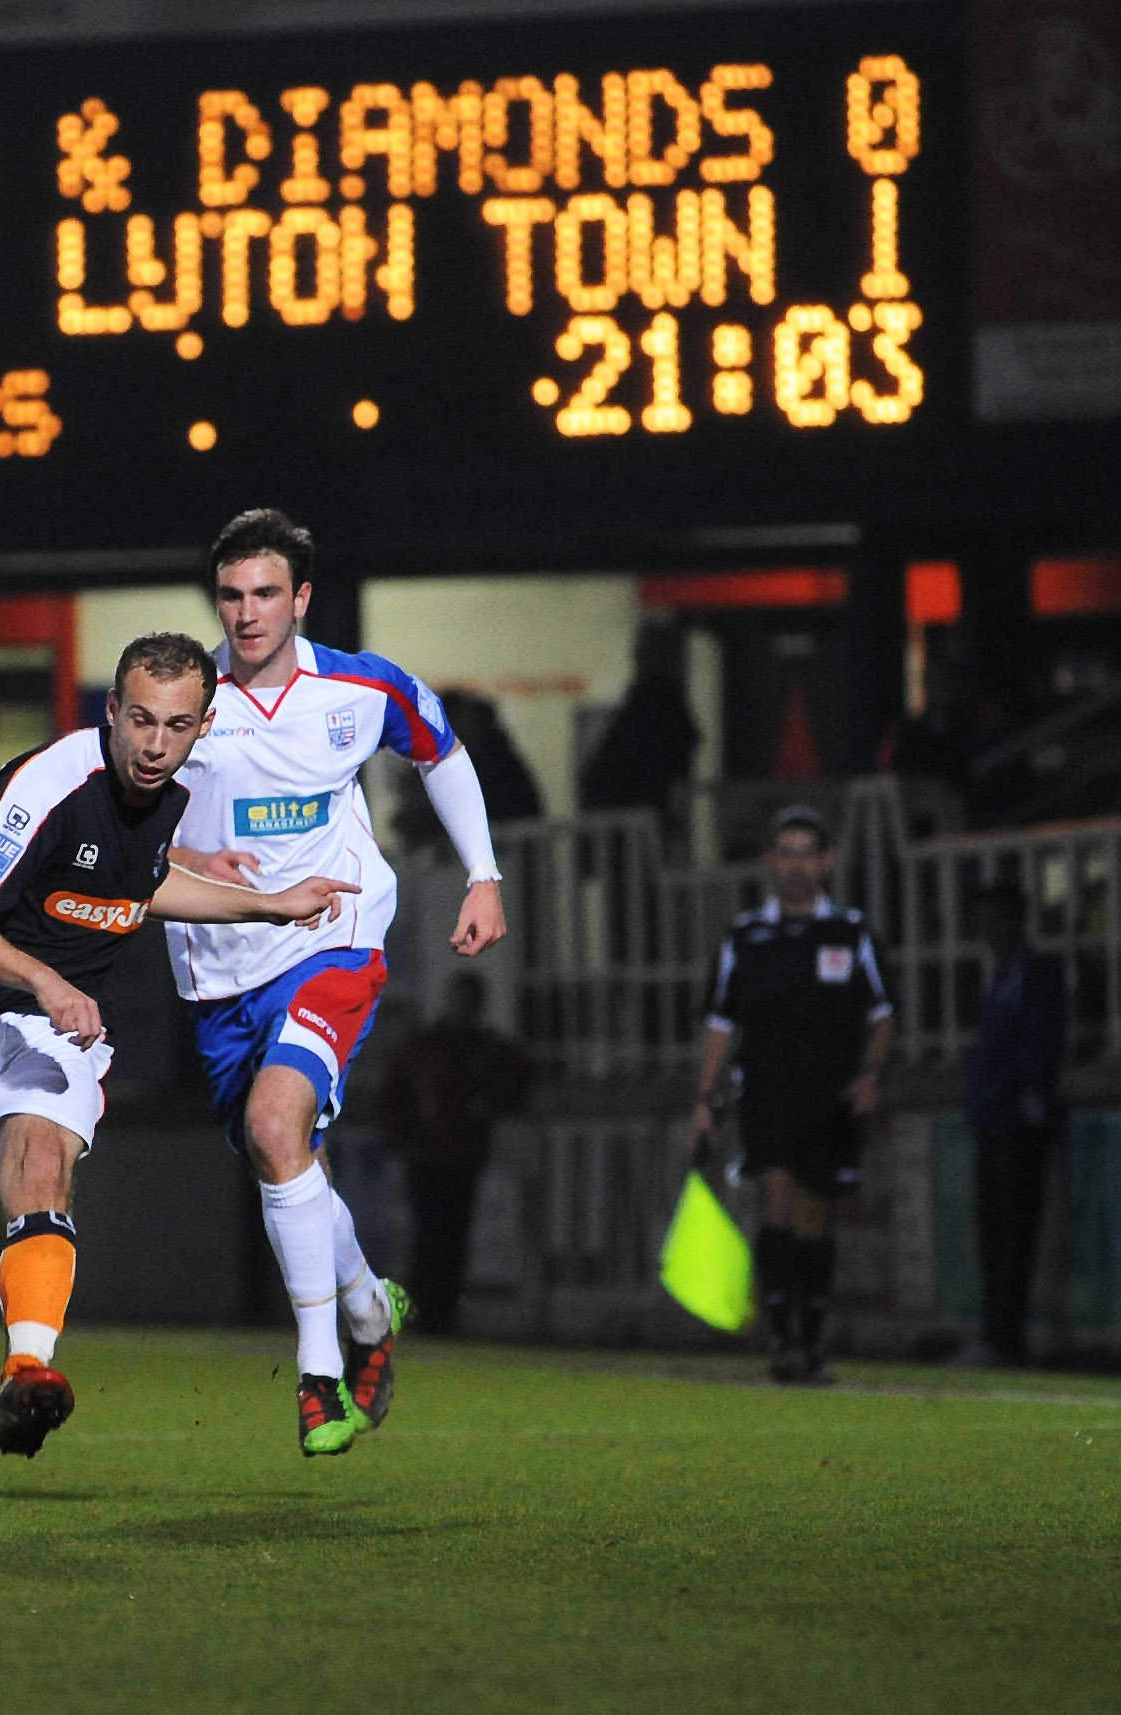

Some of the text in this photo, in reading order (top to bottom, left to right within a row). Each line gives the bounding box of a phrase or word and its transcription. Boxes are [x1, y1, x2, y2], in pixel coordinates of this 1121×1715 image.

[57, 98, 131, 213] &
[198, 64, 773, 205] DIAMONDS
[846, 55, 921, 174] 0
[56, 203, 415, 335] LUTON
[482, 185, 776, 315] TOWN
[554, 301, 924, 438] 21:03
[248, 801, 318, 821] elite
[55, 898, 149, 930] easyJt
